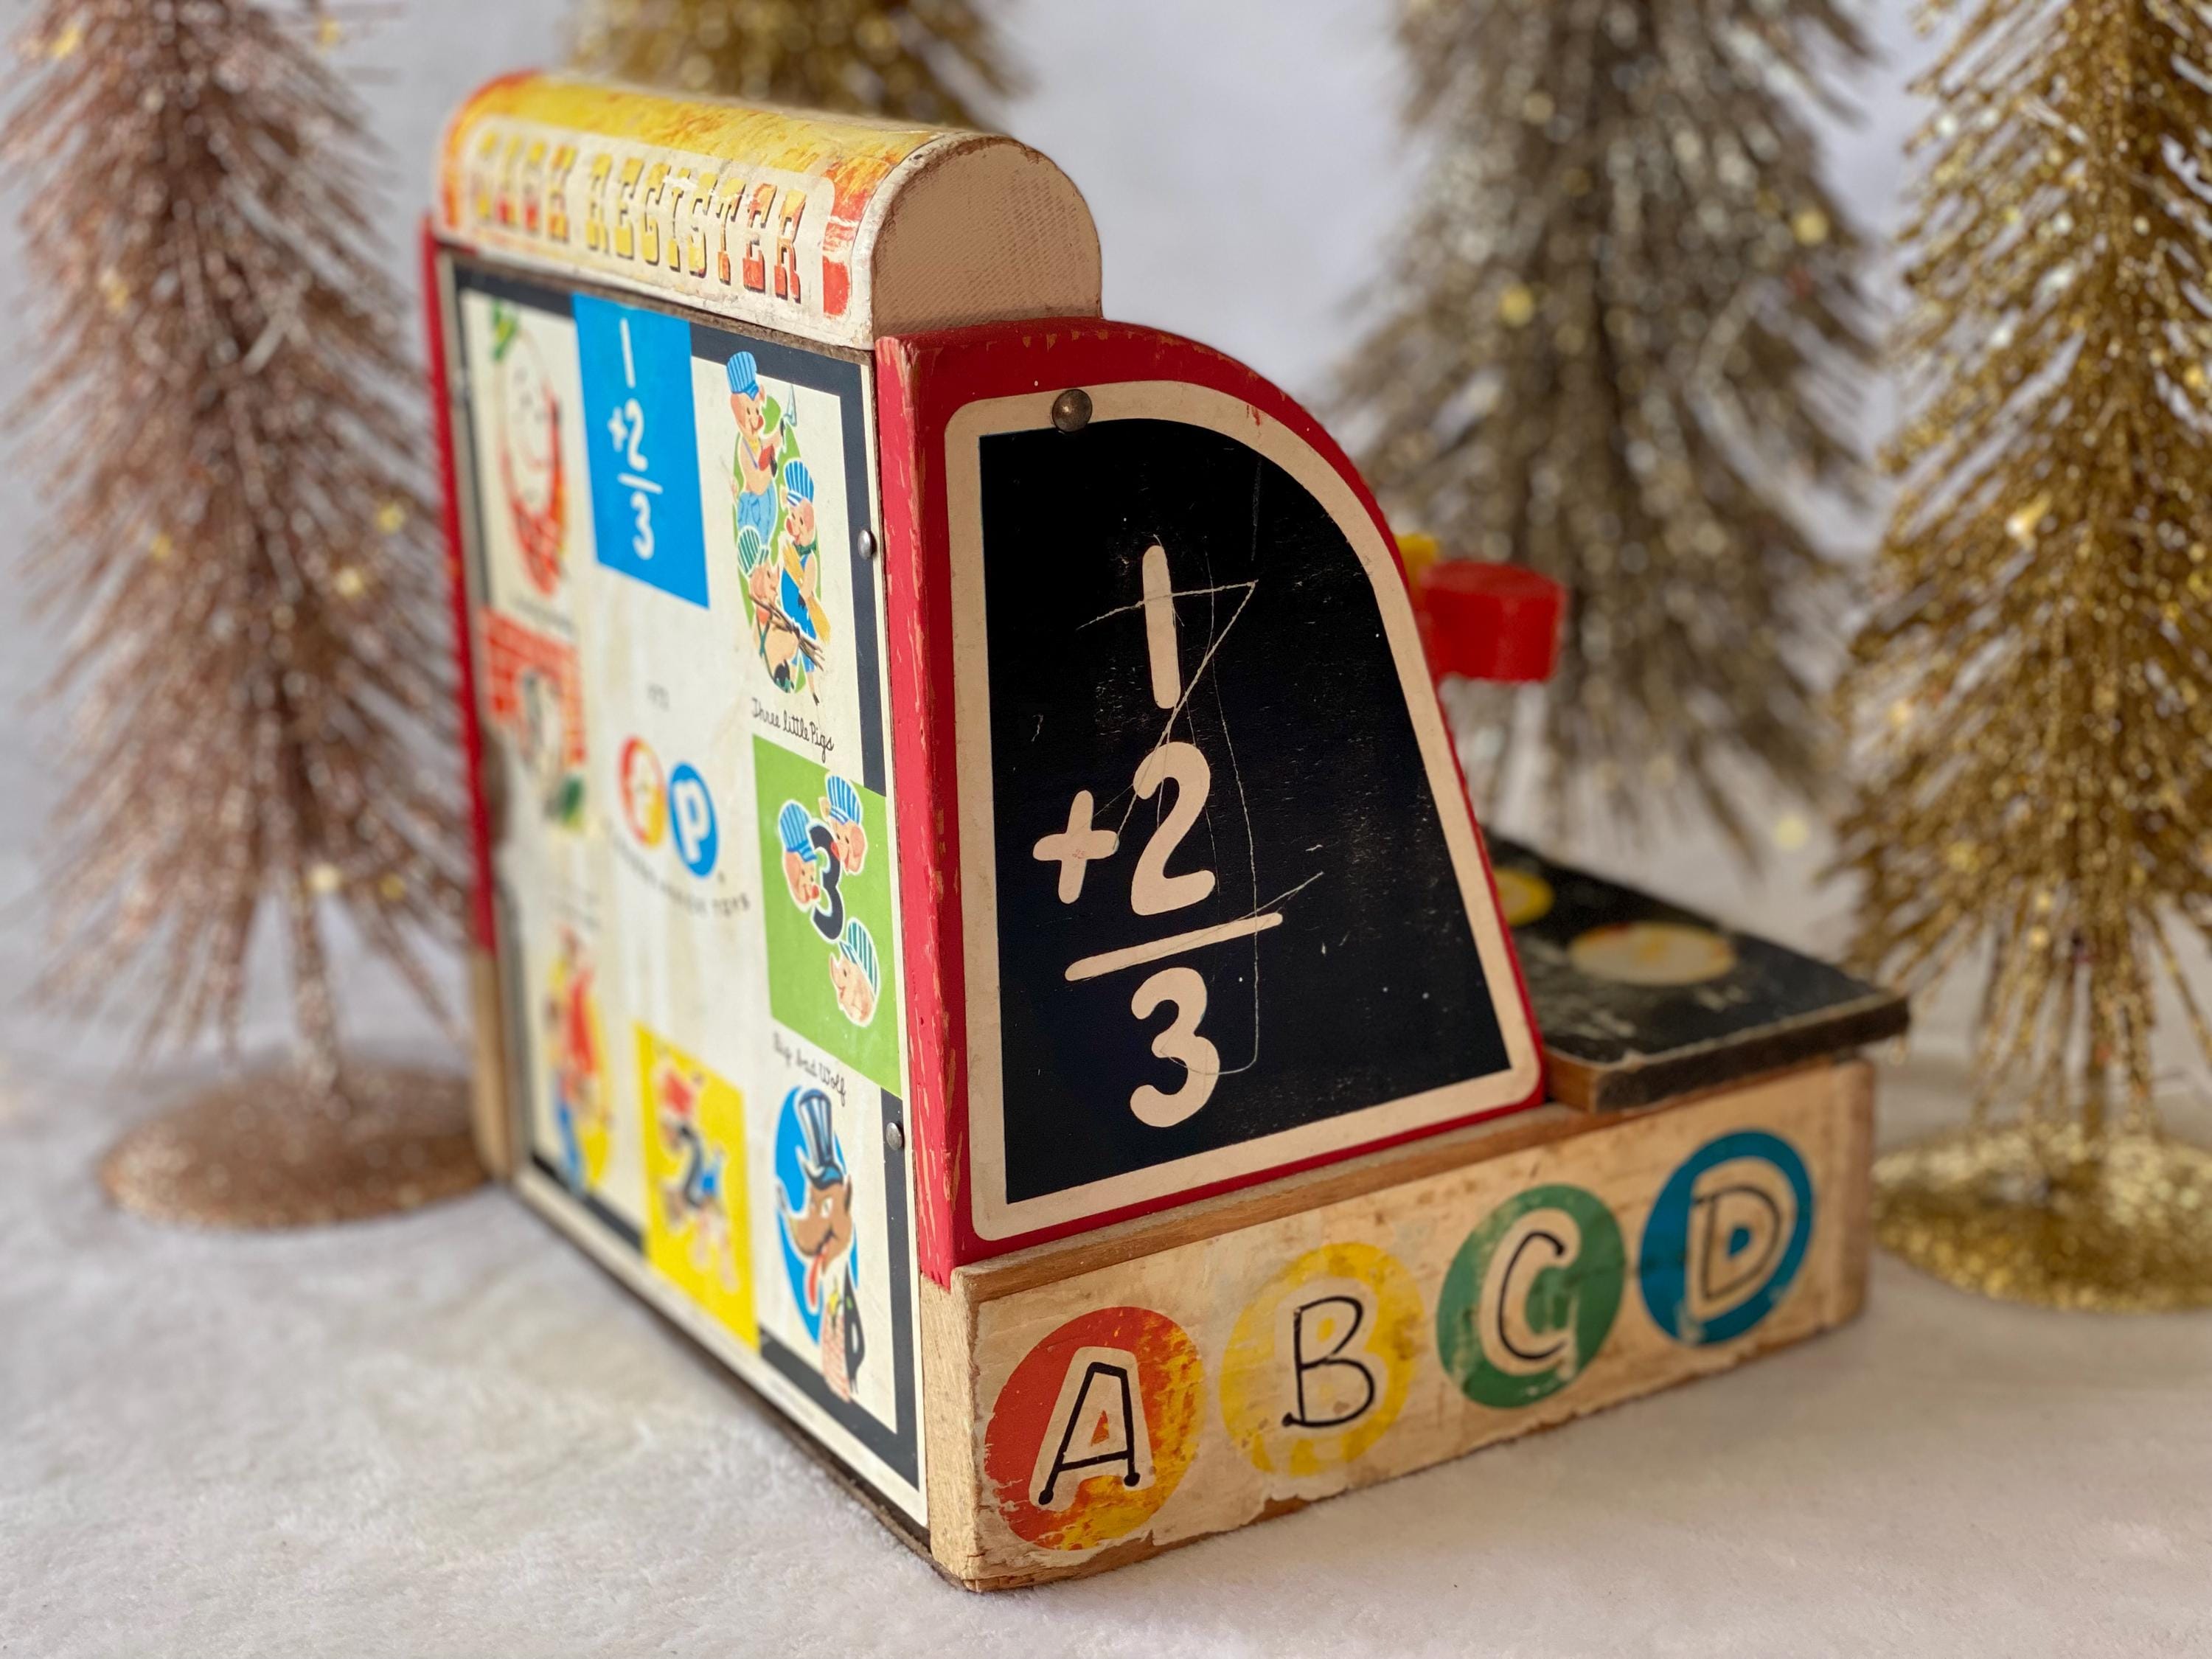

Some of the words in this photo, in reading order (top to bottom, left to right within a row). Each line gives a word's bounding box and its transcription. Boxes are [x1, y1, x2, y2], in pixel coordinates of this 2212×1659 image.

[586, 152, 806, 305] REGISTER
[620, 317, 636, 389] 1
[630, 490, 655, 560] 3
[1142, 544, 1180, 709] 1
[751, 697, 781, 728] Three
[783, 709, 810, 742] little
[810, 720, 835, 764] Pigs
[809, 824, 844, 940] 3
[818, 1062, 846, 1107] Wolf
[1130, 967, 1220, 1128] 3
[1030, 1346, 1152, 1510] A
[1276, 1281, 1383, 1434] B
[1484, 1211, 1579, 1371] C
[1687, 1157, 1797, 1320] D
